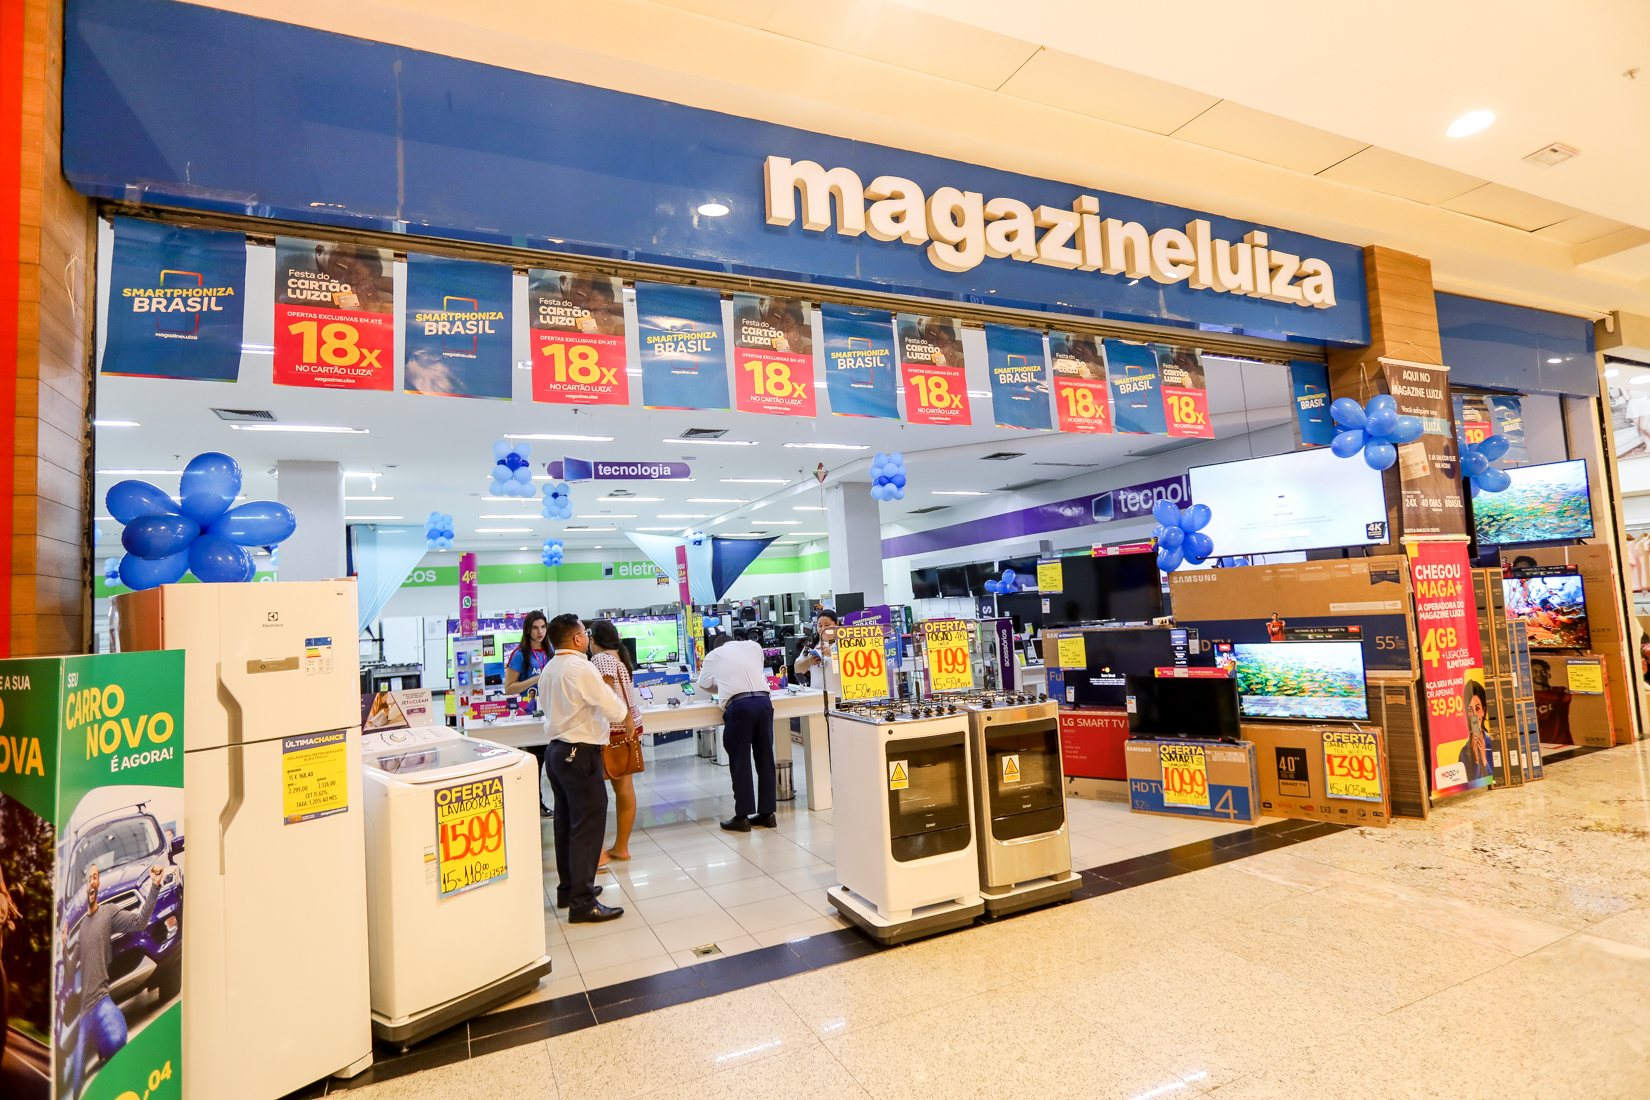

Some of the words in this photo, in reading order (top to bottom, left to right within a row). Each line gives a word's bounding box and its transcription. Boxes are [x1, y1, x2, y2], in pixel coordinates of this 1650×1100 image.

[764, 155, 1336, 308] magazineluiza
[289, 268, 313, 279] Festa
[315, 272, 330, 280] do
[287, 279, 352, 293] CARTÃO
[122, 287, 235, 298] SMARTPHONIZA
[287, 288, 332, 303] LUIZA
[133, 297, 223, 313] BRASIL
[539, 298, 561, 307] Festa
[562, 300, 573, 308] do
[287, 311, 317, 319] OFERTAS
[318, 313, 357, 322] EXCLUSIVAS
[415, 311, 504, 321] SMARTPHONIZA
[539, 305, 591, 318] CARTÃO
[539, 315, 576, 327] LUIZA
[742, 318, 760, 327] Festa
[424, 320, 496, 336] BRASIL
[741, 327, 784, 338] CARTÃO
[565, 336, 597, 345] EXCLUSIVAS
[646, 331, 718, 344] SMARTPHONIZA
[741, 335, 772, 346] LUIZA
[288, 321, 382, 369] 18x
[654, 340, 712, 356] BRASIL
[905, 344, 941, 354] CARTÃO
[831, 349, 890, 359] SMARTPHONIZA
[906, 351, 931, 361] LUIZA
[541, 343, 619, 386] 18x
[837, 356, 885, 370] BRASIL
[295, 364, 309, 373] NO
[311, 364, 346, 376] CARTÃO
[994, 365, 1042, 375] SMARTPHONIZA
[743, 360, 808, 399] 18x
[999, 372, 1038, 385] BRASIL
[1114, 374, 1156, 386] SMARTPHONIZA
[1402, 370, 1419, 382] AQUI
[1420, 372, 1431, 383] NO
[562, 383, 590, 392] CARTÃO
[909, 374, 964, 409] 18x
[1119, 382, 1153, 394] BRASIL
[1391, 384, 1425, 398] MAGAZINE
[1425, 388, 1443, 400] LUIZA
[761, 395, 784, 404] CARTÃO
[1060, 387, 1105, 419] 18x
[1300, 398, 1325, 410] BRASIL
[1166, 395, 1207, 425] 18x
[1400, 405, 1413, 413] Você
[1412, 407, 1429, 416] adquire
[1423, 421, 1442, 432] LUIZA
[598, 462, 671, 479] tecnologia
[1118, 475, 1191, 513] tecnol
[1405, 498, 1417, 508] 24X
[1429, 499, 1442, 508] DIAS
[1445, 499, 1463, 508] BRASIL
[1367, 523, 1382, 531] 4K
[404, 570, 437, 584] cos
[1415, 564, 1460, 580] CHEGOU
[1173, 573, 1217, 584] SAMSUNG
[1416, 580, 1462, 599] MAGA+
[1423, 602, 1456, 611] OPERADORA
[1456, 600, 1464, 608] DO
[1419, 611, 1449, 620] MAGAZINE
[1449, 609, 1465, 618] LUIZA
[836, 626, 883, 638] OFERTA
[924, 620, 967, 632] OFERTA
[1001, 629, 1010, 667] acessórios
[1375, 636, 1396, 650] 55
[1422, 627, 1457, 667] 4GB
[843, 649, 883, 677] 699
[1446, 658, 1475, 669] ILIMITADAS
[67, 672, 79, 688] SEU
[1049, 671, 1064, 681] Ful
[4, 676, 11, 690] A
[12, 675, 31, 690] SUA
[1425, 681, 1437, 690] AÇA
[1437, 680, 1447, 688] SEU
[1447, 677, 1463, 687] PLANO
[1435, 688, 1454, 697] APENAS
[65, 683, 125, 730] CARRO
[1431, 695, 1463, 717] 39,90
[1062, 718, 1074, 726] LG
[1076, 718, 1109, 727] SMART
[1111, 719, 1125, 728] TV
[86, 711, 175, 760] NOVO
[1322, 732, 1376, 744] OFERTA
[0, 735, 45, 776] OVA
[1160, 745, 1205, 755] OFERTA
[110, 754, 119, 773] É
[120, 747, 174, 771] AGORA!
[1160, 754, 1194, 764] SMART
[1326, 754, 1377, 781] 1399
[299, 771, 314, 779] 168,40
[317, 780, 337, 788] 2.526,00
[1132, 781, 1149, 792] HD
[1164, 767, 1206, 796] 1099
[288, 785, 308, 794] 2.299,00
[436, 778, 503, 805] OFERTA
[309, 798, 322, 806] 1,20%
[441, 796, 490, 817] LAVADORA
[1214, 789, 1238, 819] 4
[440, 809, 502, 862] 1599
